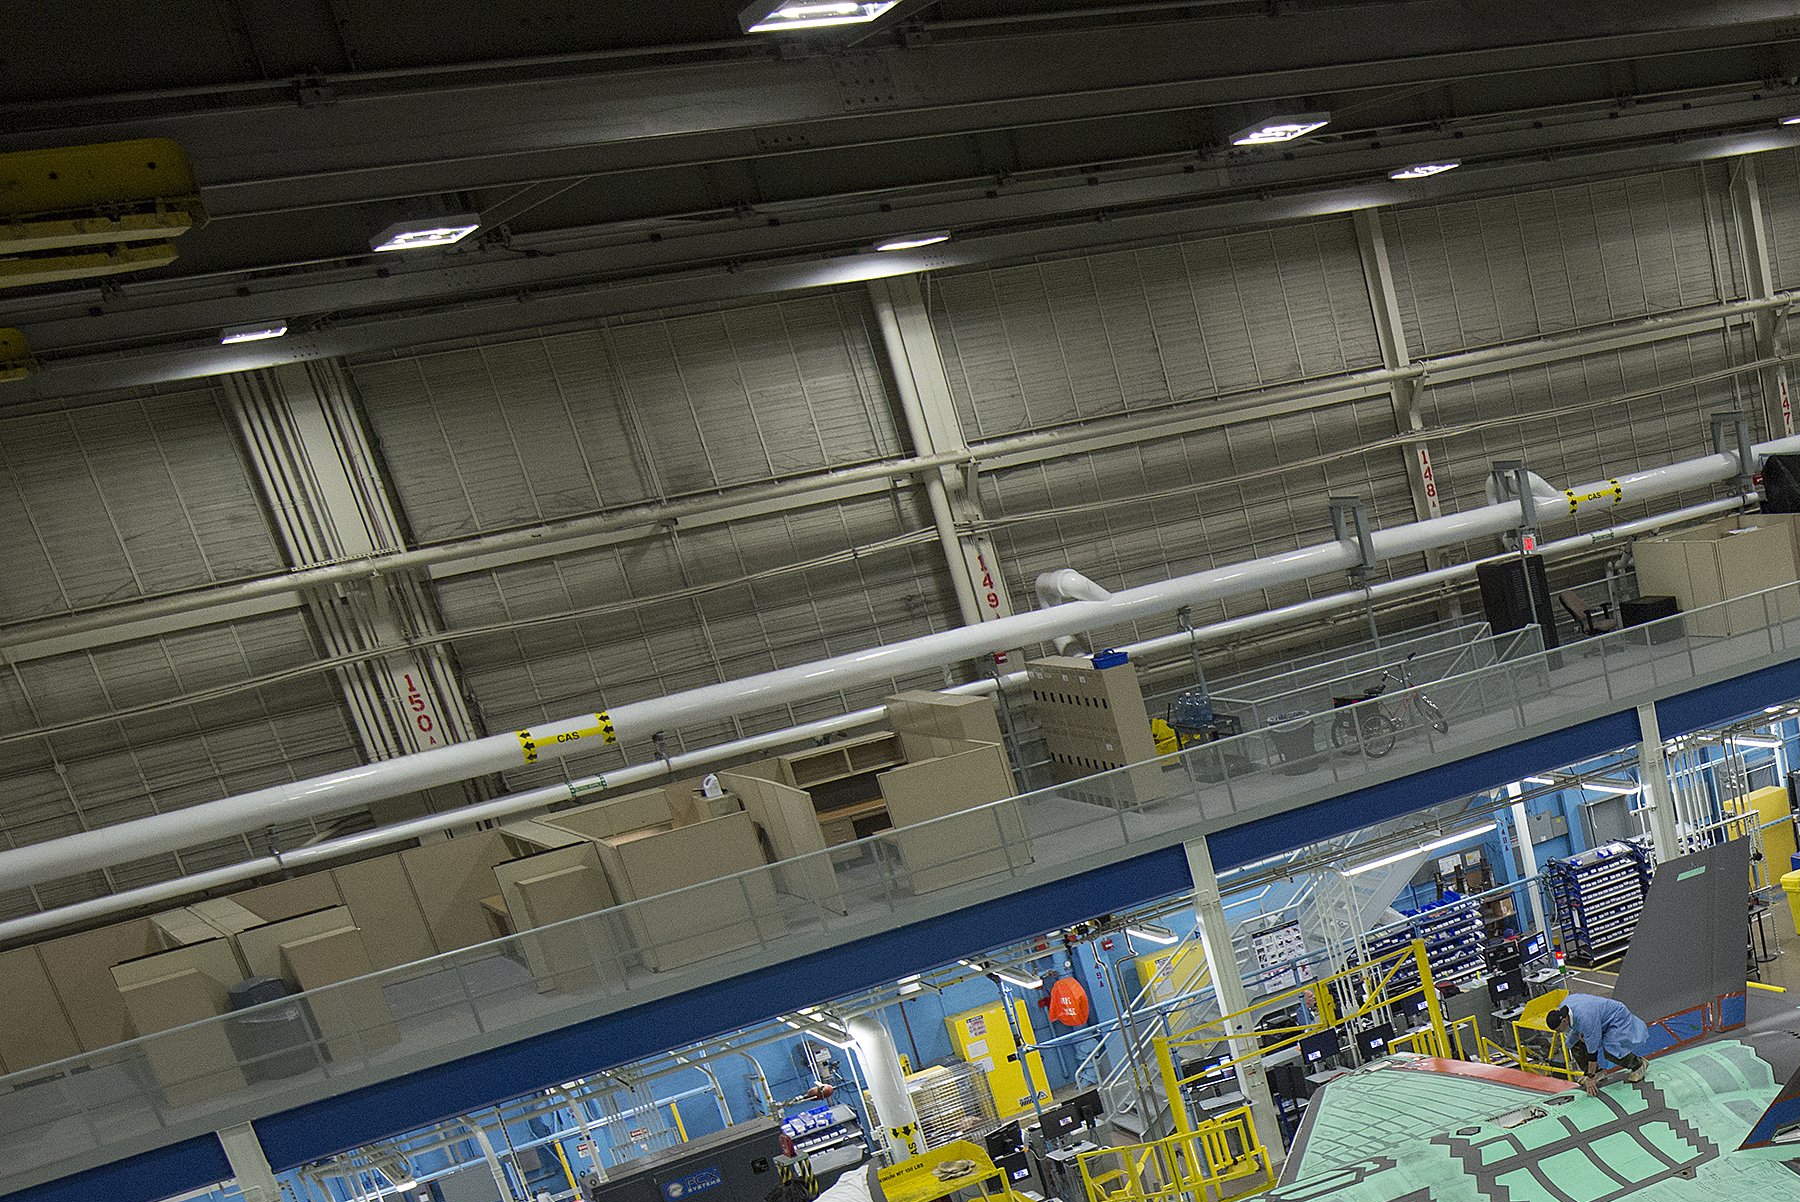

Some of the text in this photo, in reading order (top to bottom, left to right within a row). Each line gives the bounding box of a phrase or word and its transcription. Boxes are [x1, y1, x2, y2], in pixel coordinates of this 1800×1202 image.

[1780, 381, 1792, 426] 147
[1421, 449, 1437, 499] 148
[1586, 491, 1602, 503] CAS
[976, 554, 1000, 609] 149
[402, 673, 434, 733] 150
[556, 731, 581, 745] CAS
